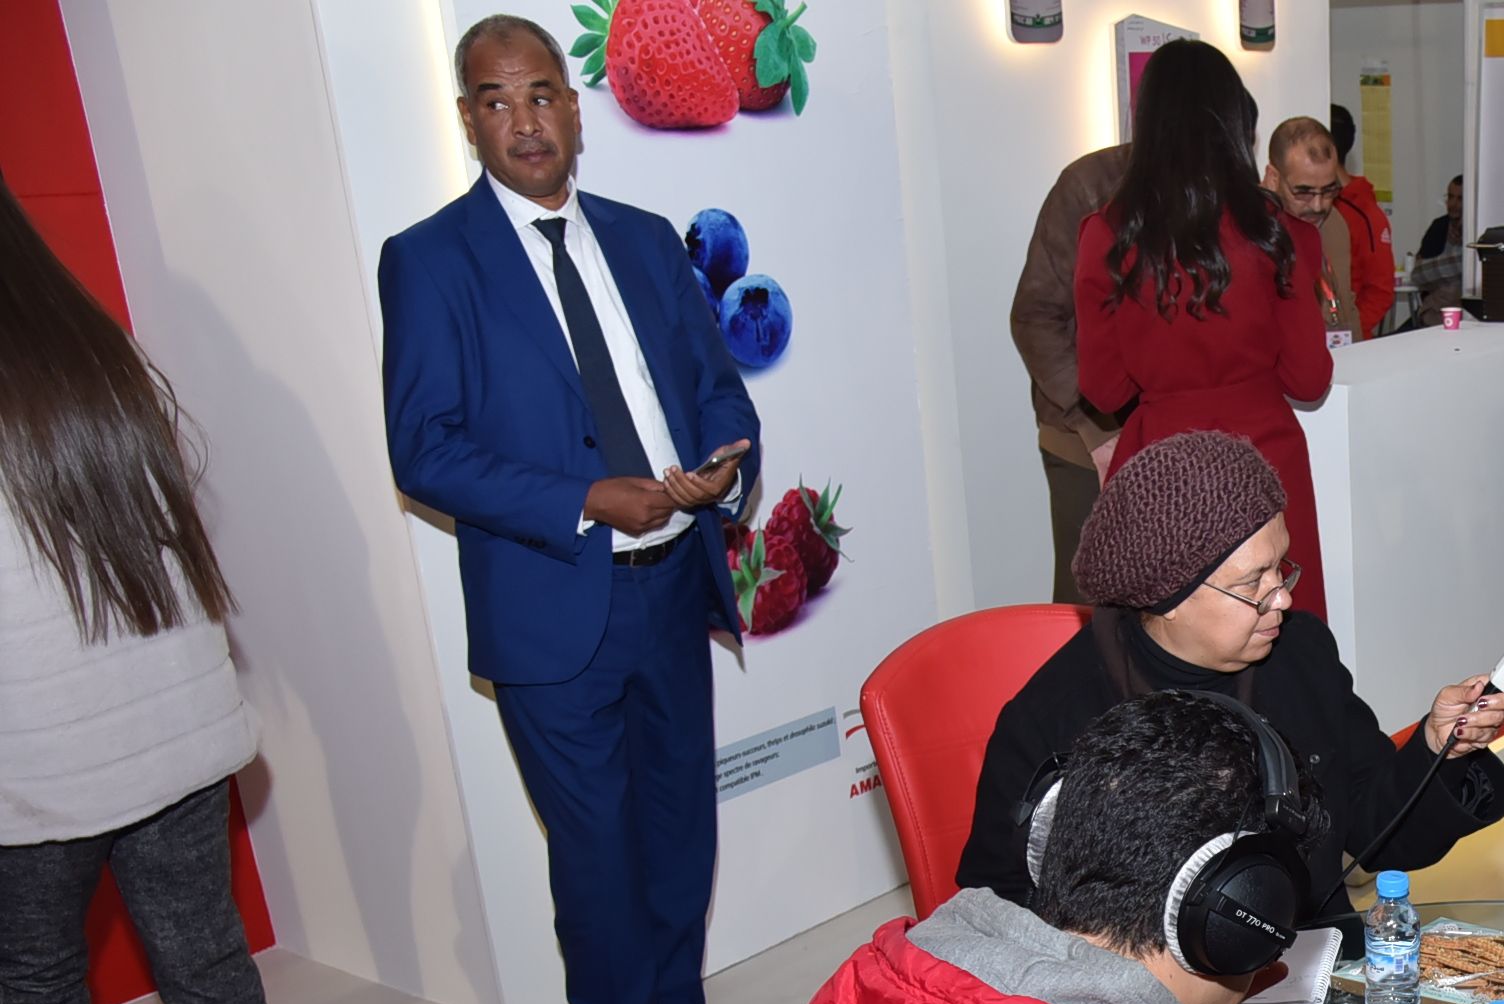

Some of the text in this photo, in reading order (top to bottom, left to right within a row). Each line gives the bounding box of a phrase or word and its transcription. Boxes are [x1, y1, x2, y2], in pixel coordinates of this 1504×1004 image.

[850, 774, 882, 799] AMA
[1235, 909, 1276, 934] DT 770 PRO
